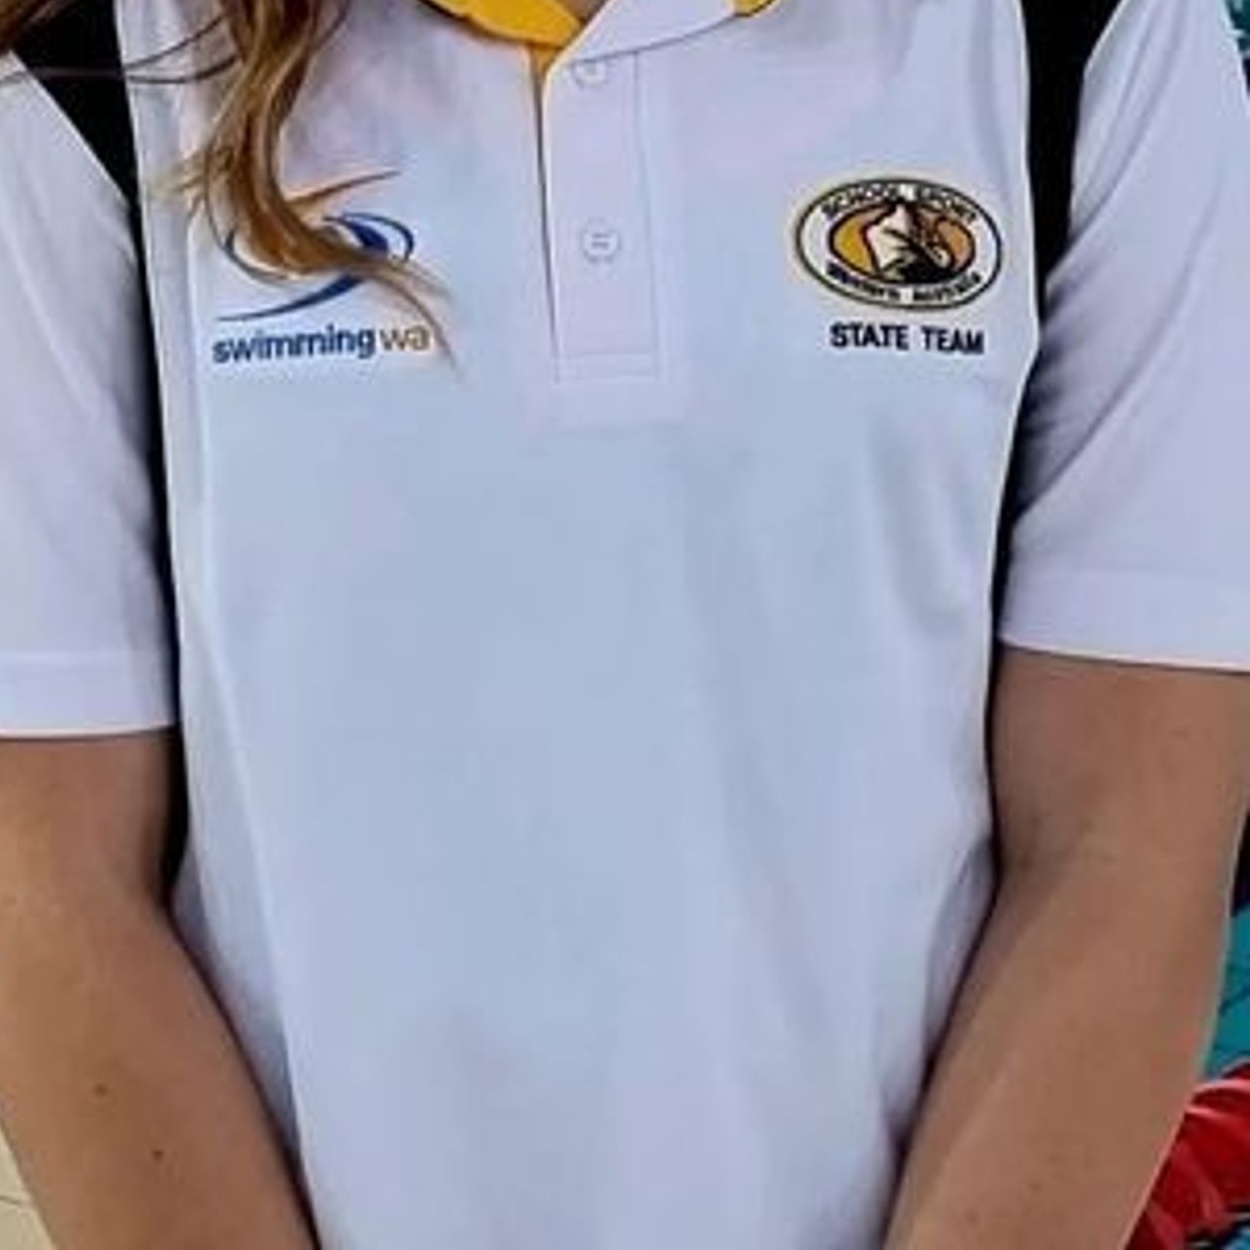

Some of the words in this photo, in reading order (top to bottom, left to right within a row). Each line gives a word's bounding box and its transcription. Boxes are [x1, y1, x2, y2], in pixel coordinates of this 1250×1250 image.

[211, 322, 377, 364] swimming
[379, 324, 432, 352] wa
[829, 321, 910, 351] STATE
[920, 324, 985, 355] TEAM
